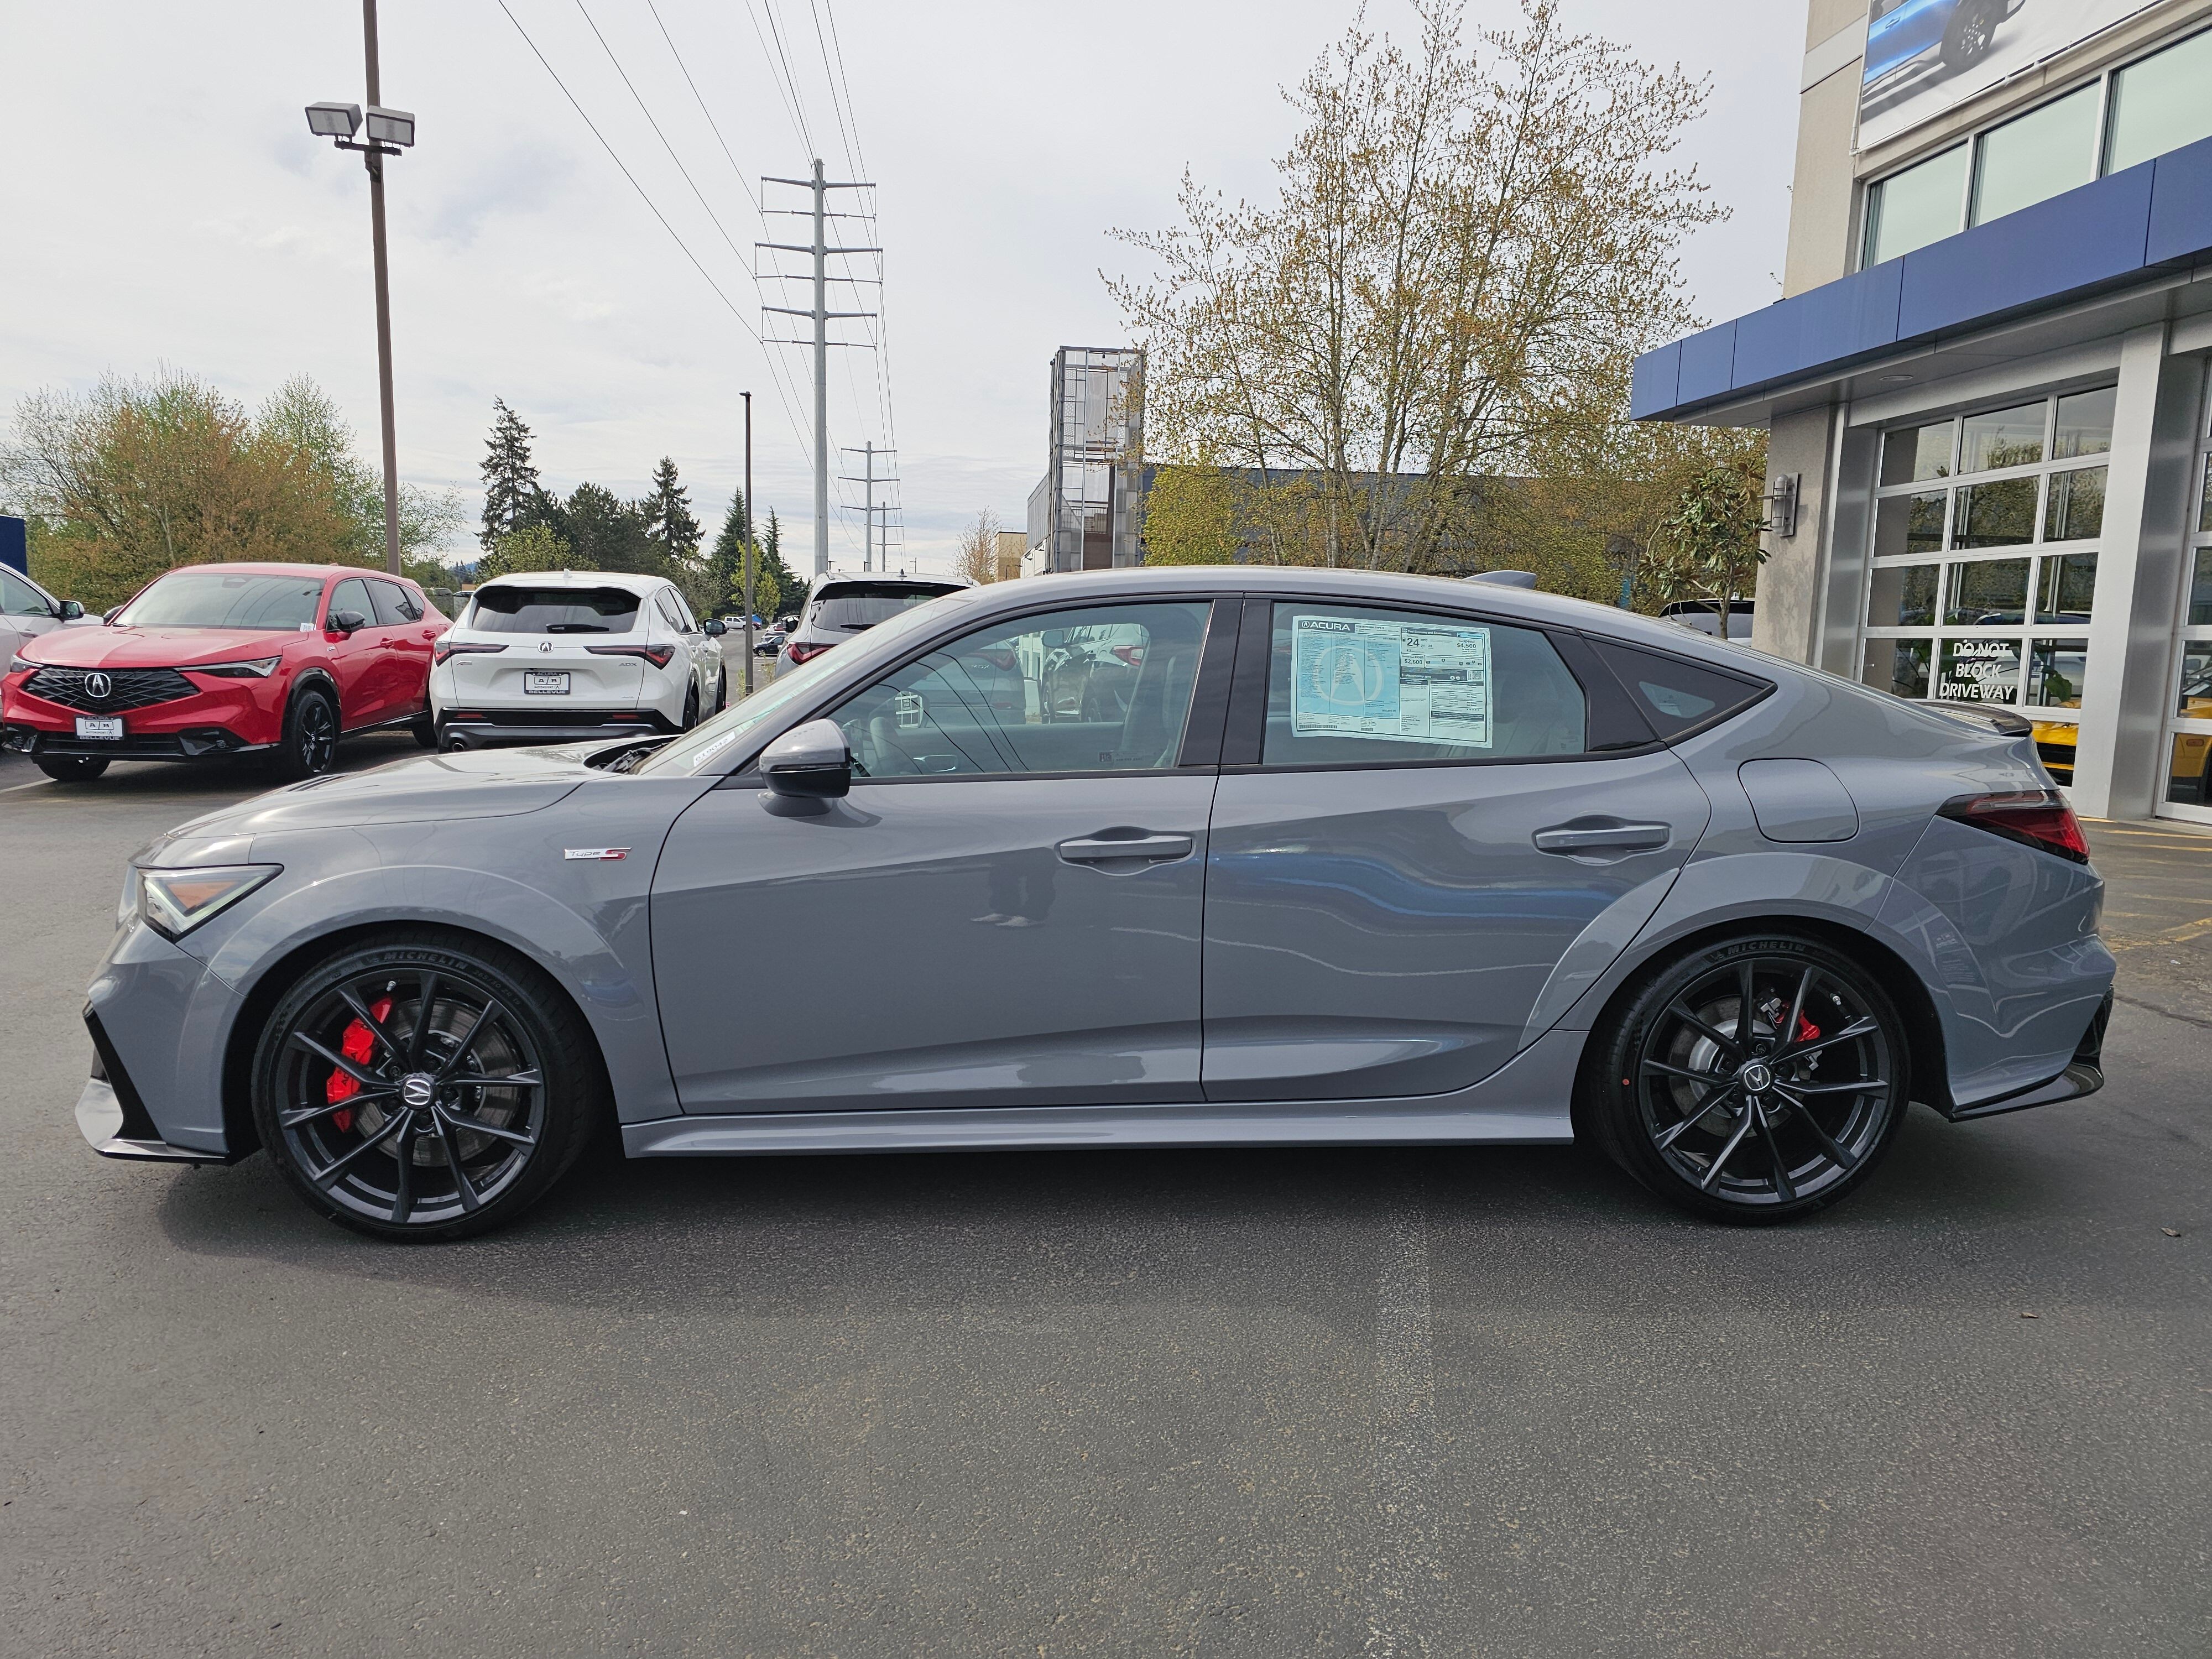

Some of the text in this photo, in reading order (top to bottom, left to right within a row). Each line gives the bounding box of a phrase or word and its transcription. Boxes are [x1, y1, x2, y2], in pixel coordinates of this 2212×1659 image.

[1310, 621, 1350, 631] ACURA
[1407, 638, 1420, 646] 24
[1953, 643, 2009, 657] DO NOT
[1955, 664, 2002, 678] BLOCK
[1939, 682, 2014, 700] DRIVEWAY
[1728, 941, 1806, 954] MICHELIN
[384, 951, 468, 969] MICHELIN
